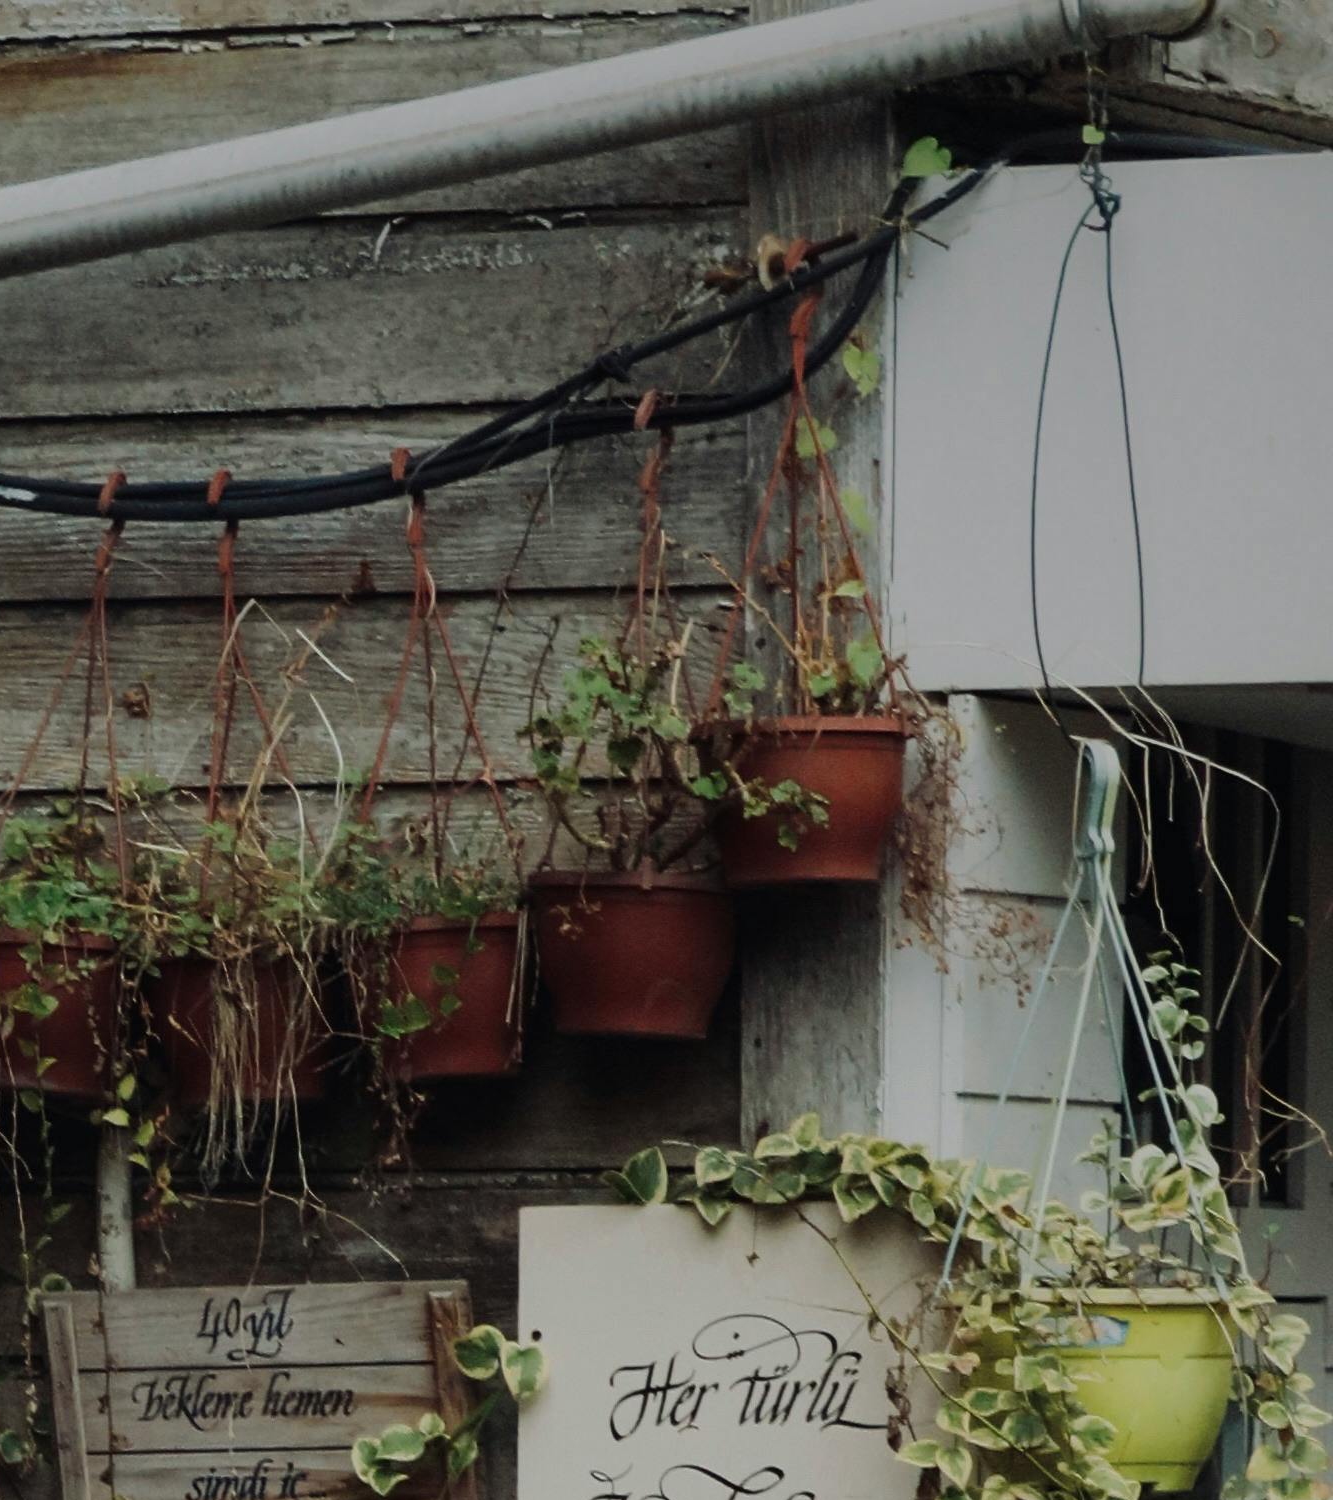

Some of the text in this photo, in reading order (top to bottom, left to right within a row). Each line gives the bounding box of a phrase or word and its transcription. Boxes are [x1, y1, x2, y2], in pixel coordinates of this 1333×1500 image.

[196, 1297, 242, 1355] 40
[261, 1370, 357, 1418] hemen
[610, 1333, 883, 1442] Her türlü
